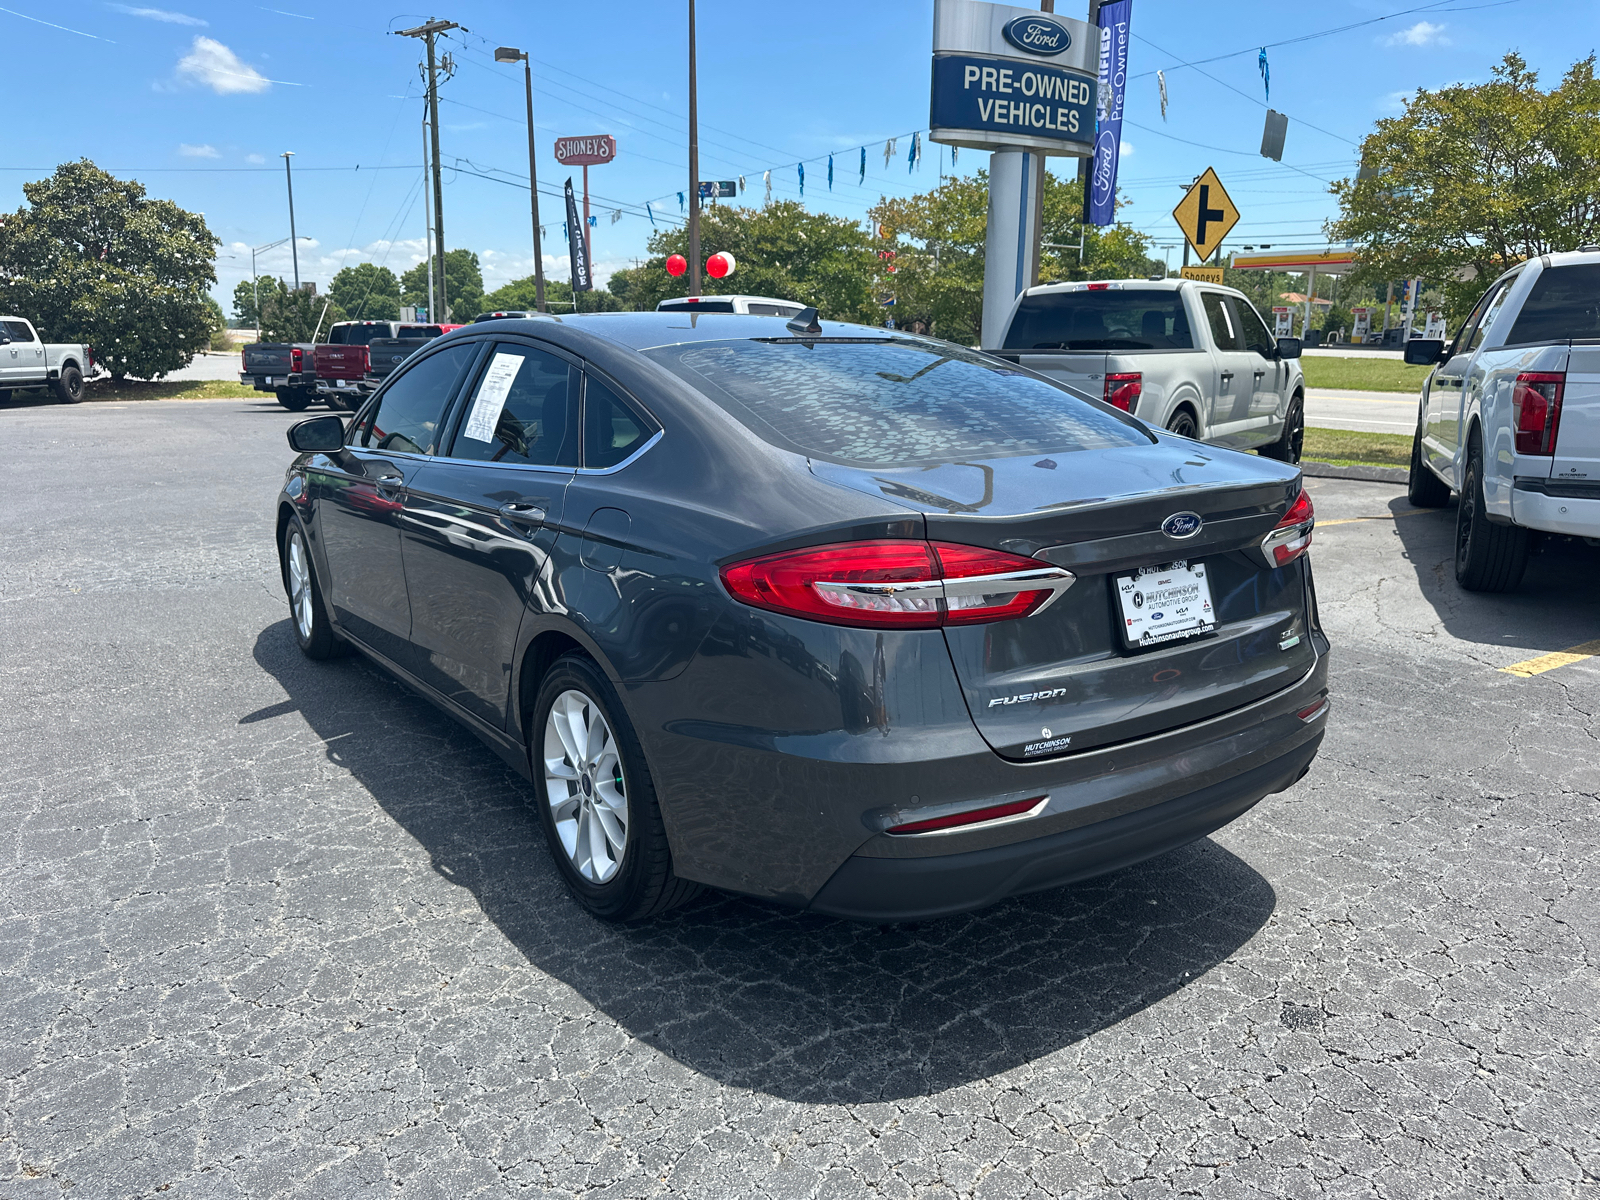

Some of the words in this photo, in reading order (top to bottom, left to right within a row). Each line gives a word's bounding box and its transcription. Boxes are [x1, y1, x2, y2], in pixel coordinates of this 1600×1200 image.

[1022, 24, 1060, 48] Ford
[1096, 26, 1112, 122] CETIFIED
[1111, 21, 1127, 121] Pre-Owned
[964, 65, 1090, 106] PRE-OWNED
[977, 98, 1080, 133] VEHICLES
[557, 137, 610, 160] SHONEY'S
[1093, 146, 1113, 192] Ford
[1184, 271, 1221, 284] Shoneys
[1172, 516, 1195, 534] Ford
[1146, 583, 1199, 603] HUTCHINSON
[1148, 597, 1181, 611] AUTOMOTIVE
[1181, 594, 1199, 604] GROUP
[1138, 624, 1215, 647] Hutchinsonautogroup.com
[988, 687, 1067, 708] FUSION
[1024, 736, 1072, 752] HUTCHINSON
